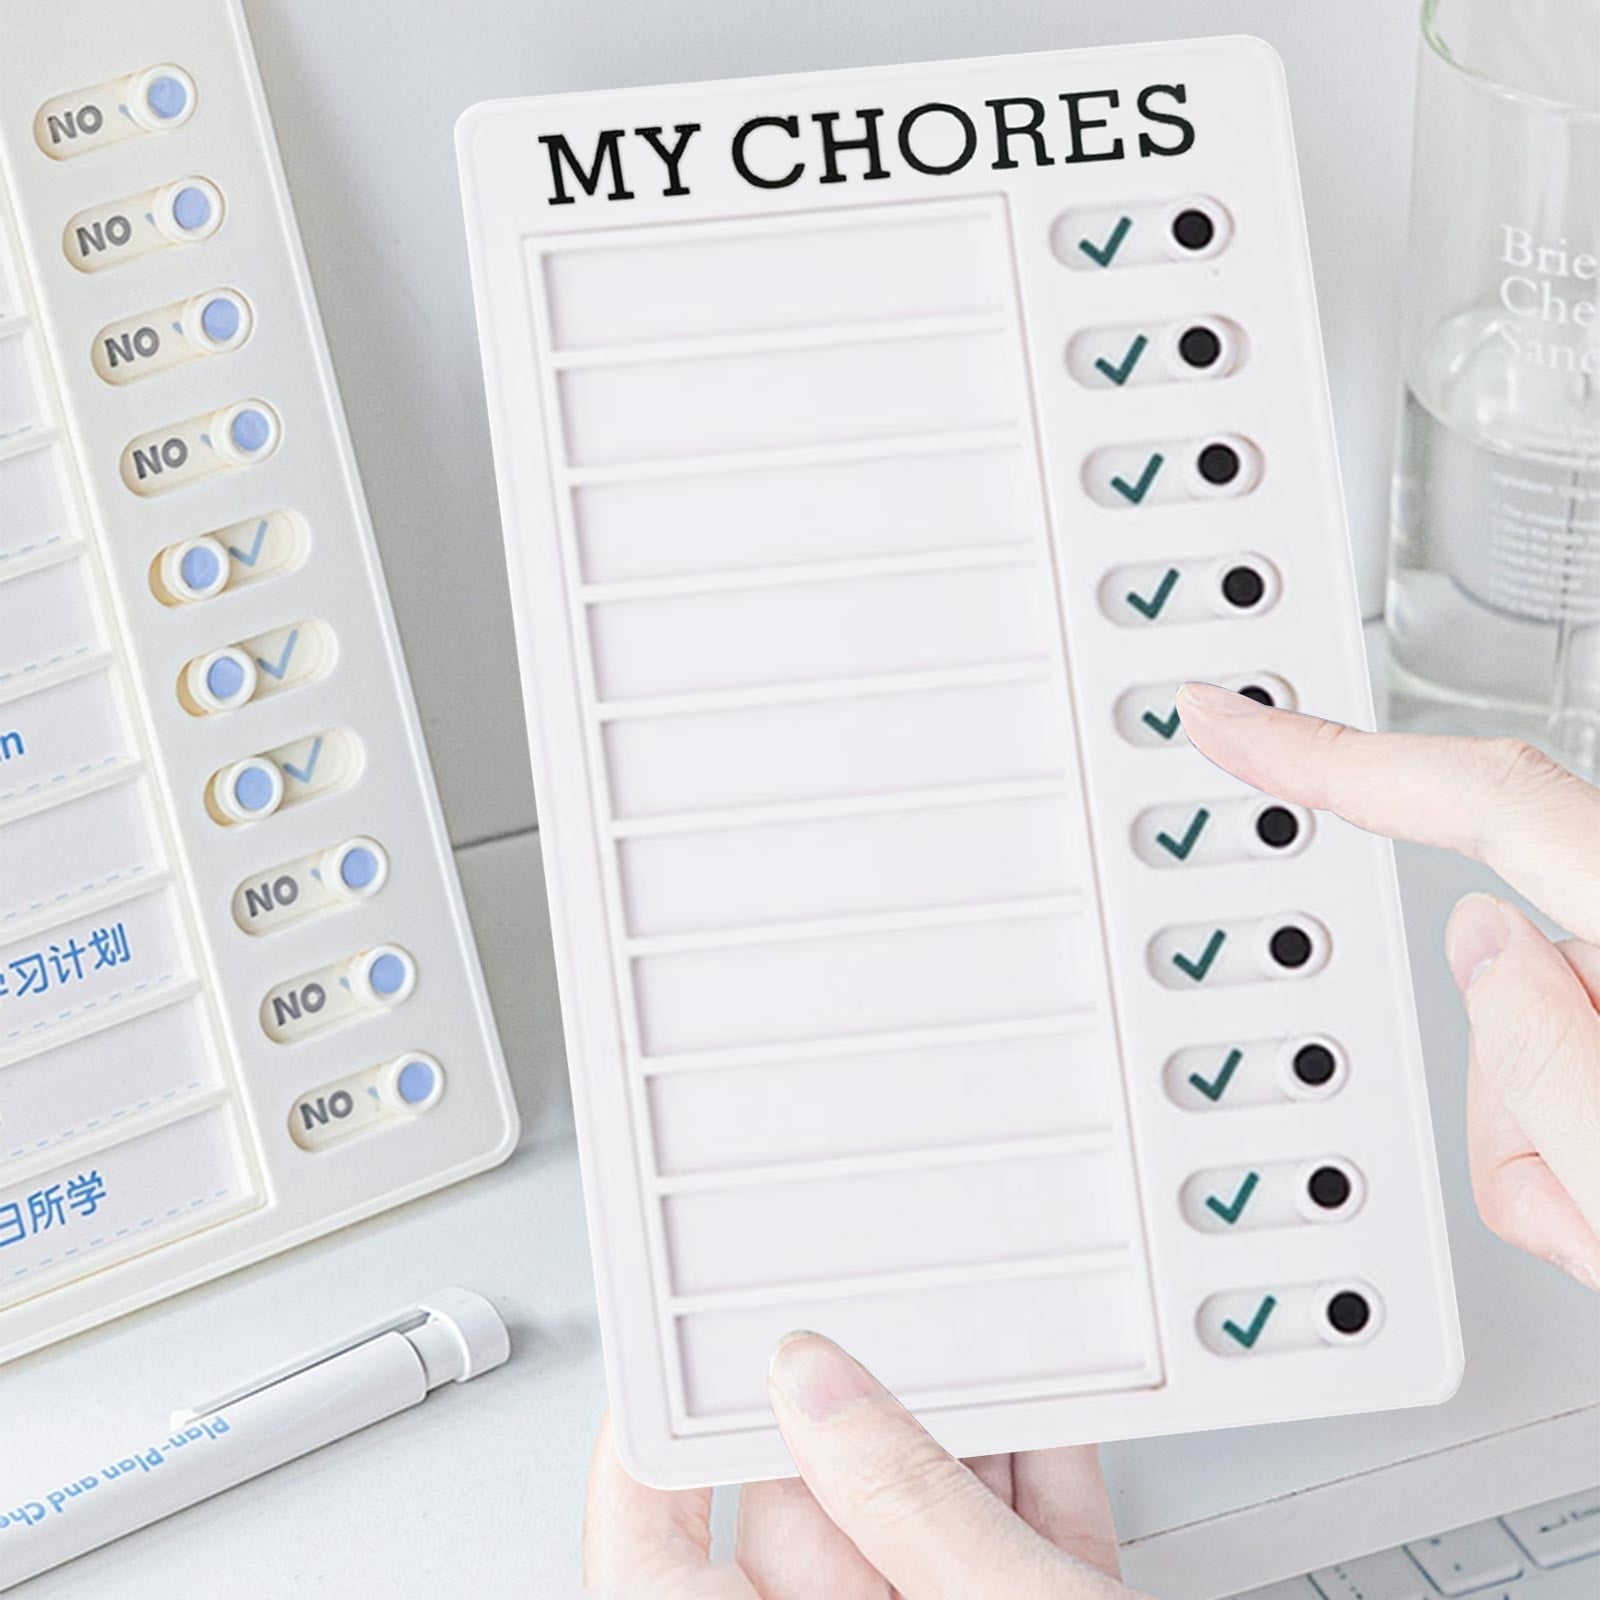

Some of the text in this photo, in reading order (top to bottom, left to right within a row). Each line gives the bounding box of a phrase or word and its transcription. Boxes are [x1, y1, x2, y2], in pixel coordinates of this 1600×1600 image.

[47, 105, 104, 144] NO
[537, 83, 1196, 206] MY CHORES
[76, 215, 132, 257] NO
[1500, 223, 1599, 280] Brie
[1500, 274, 1599, 328] Che
[105, 326, 160, 368] NO
[133, 438, 188, 480] NO
[244, 876, 299, 918] NO
[0, 922, 131, 997] 习计划
[272, 983, 327, 1027] NO
[299, 1089, 354, 1130] NO
[102, 1416, 231, 1480] Plan-Plan
[46, 1474, 99, 1514] and
